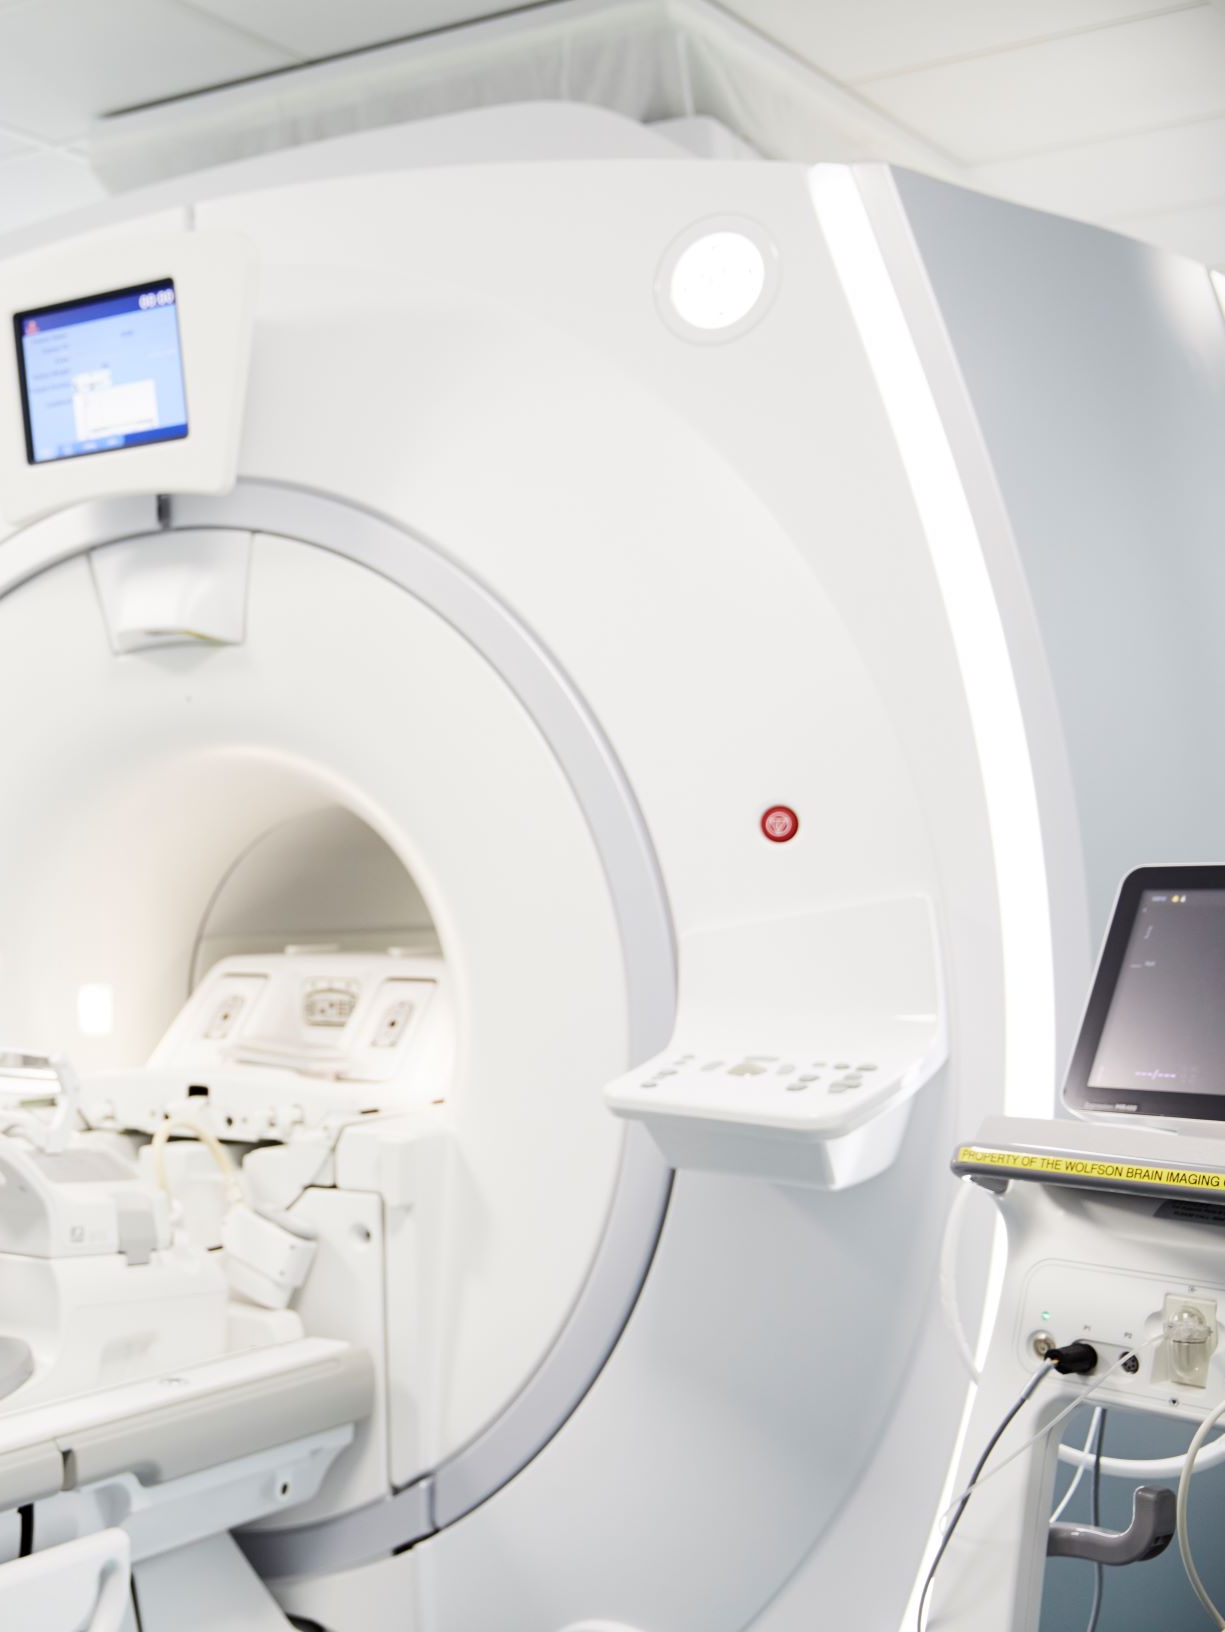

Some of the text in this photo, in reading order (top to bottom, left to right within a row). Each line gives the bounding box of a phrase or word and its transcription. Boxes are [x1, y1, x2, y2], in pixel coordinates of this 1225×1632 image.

[961, 1149, 1017, 1166] PROPERTY
[1021, 1156, 1037, 1168] OF
[1041, 1158, 1062, 1170] THE
[1065, 1161, 1123, 1177] WOLFSON
[1126, 1167, 1163, 1181] BRAIN
[1166, 1172, 1220, 1187] IMAGING
